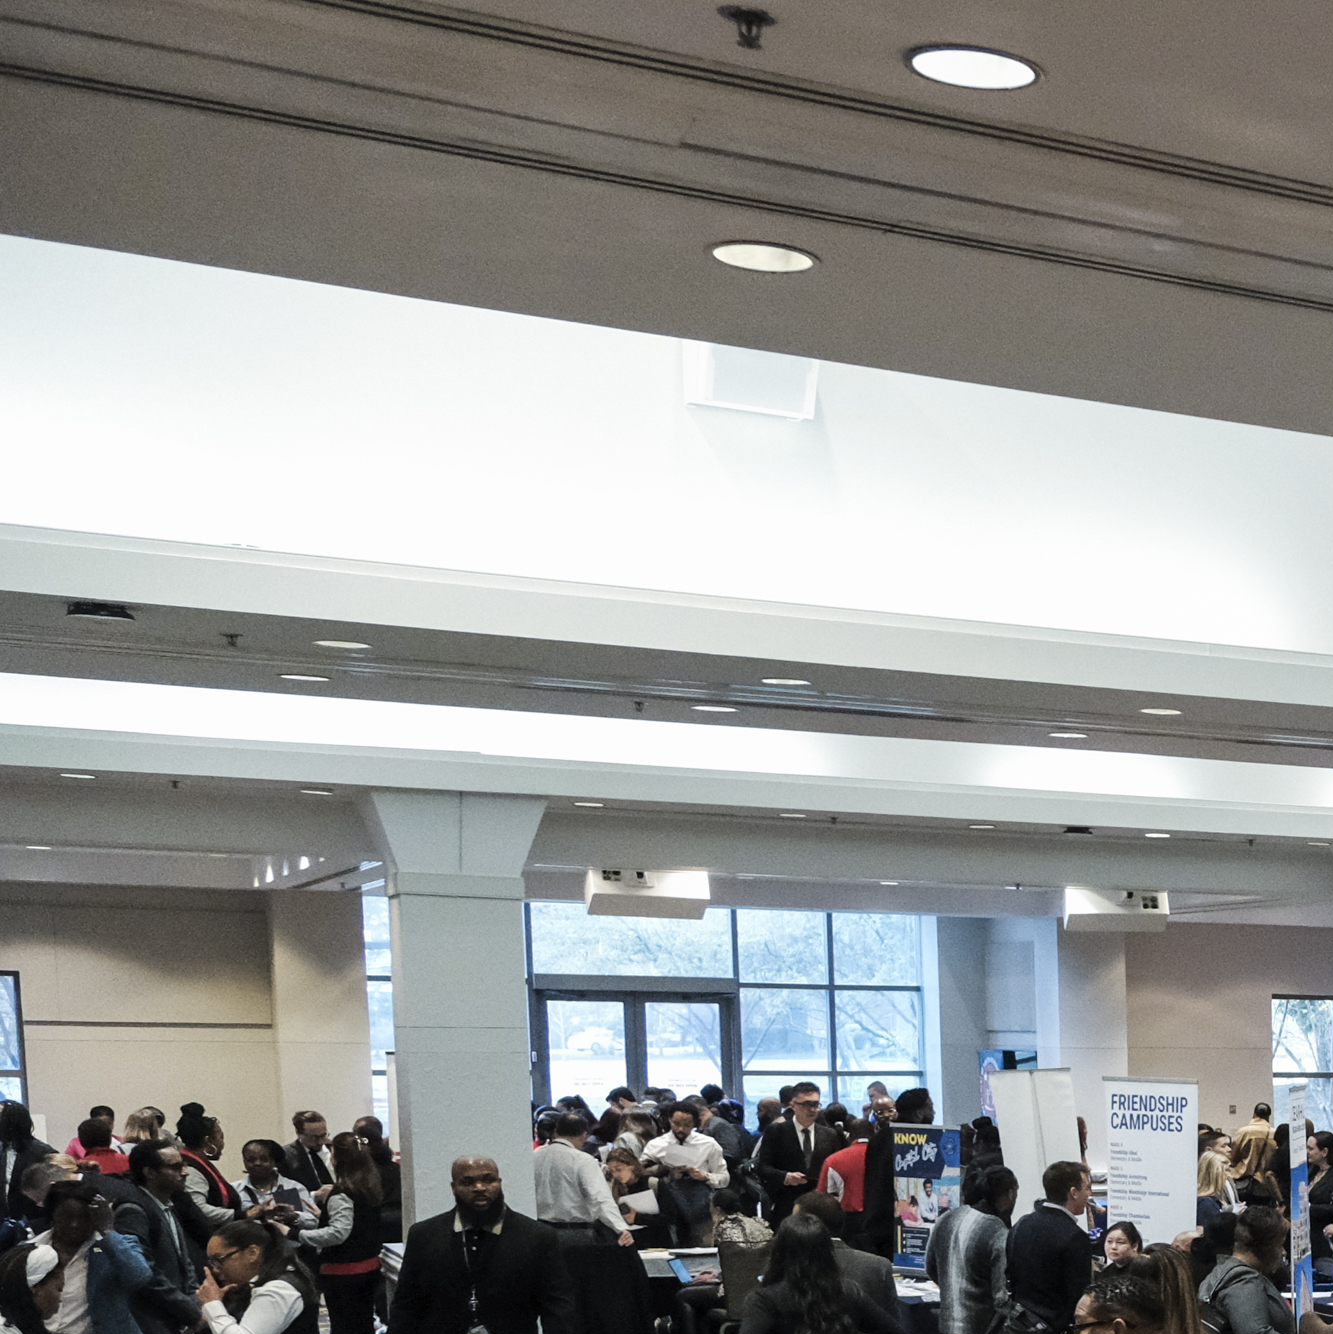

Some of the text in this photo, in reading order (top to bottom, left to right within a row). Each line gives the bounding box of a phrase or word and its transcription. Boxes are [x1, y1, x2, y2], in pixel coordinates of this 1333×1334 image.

[1110, 1093, 1188, 1114] FRIENDSHIP
[1110, 1112, 1184, 1133] CAMPUSES
[894, 1132, 927, 1145] KNOW
